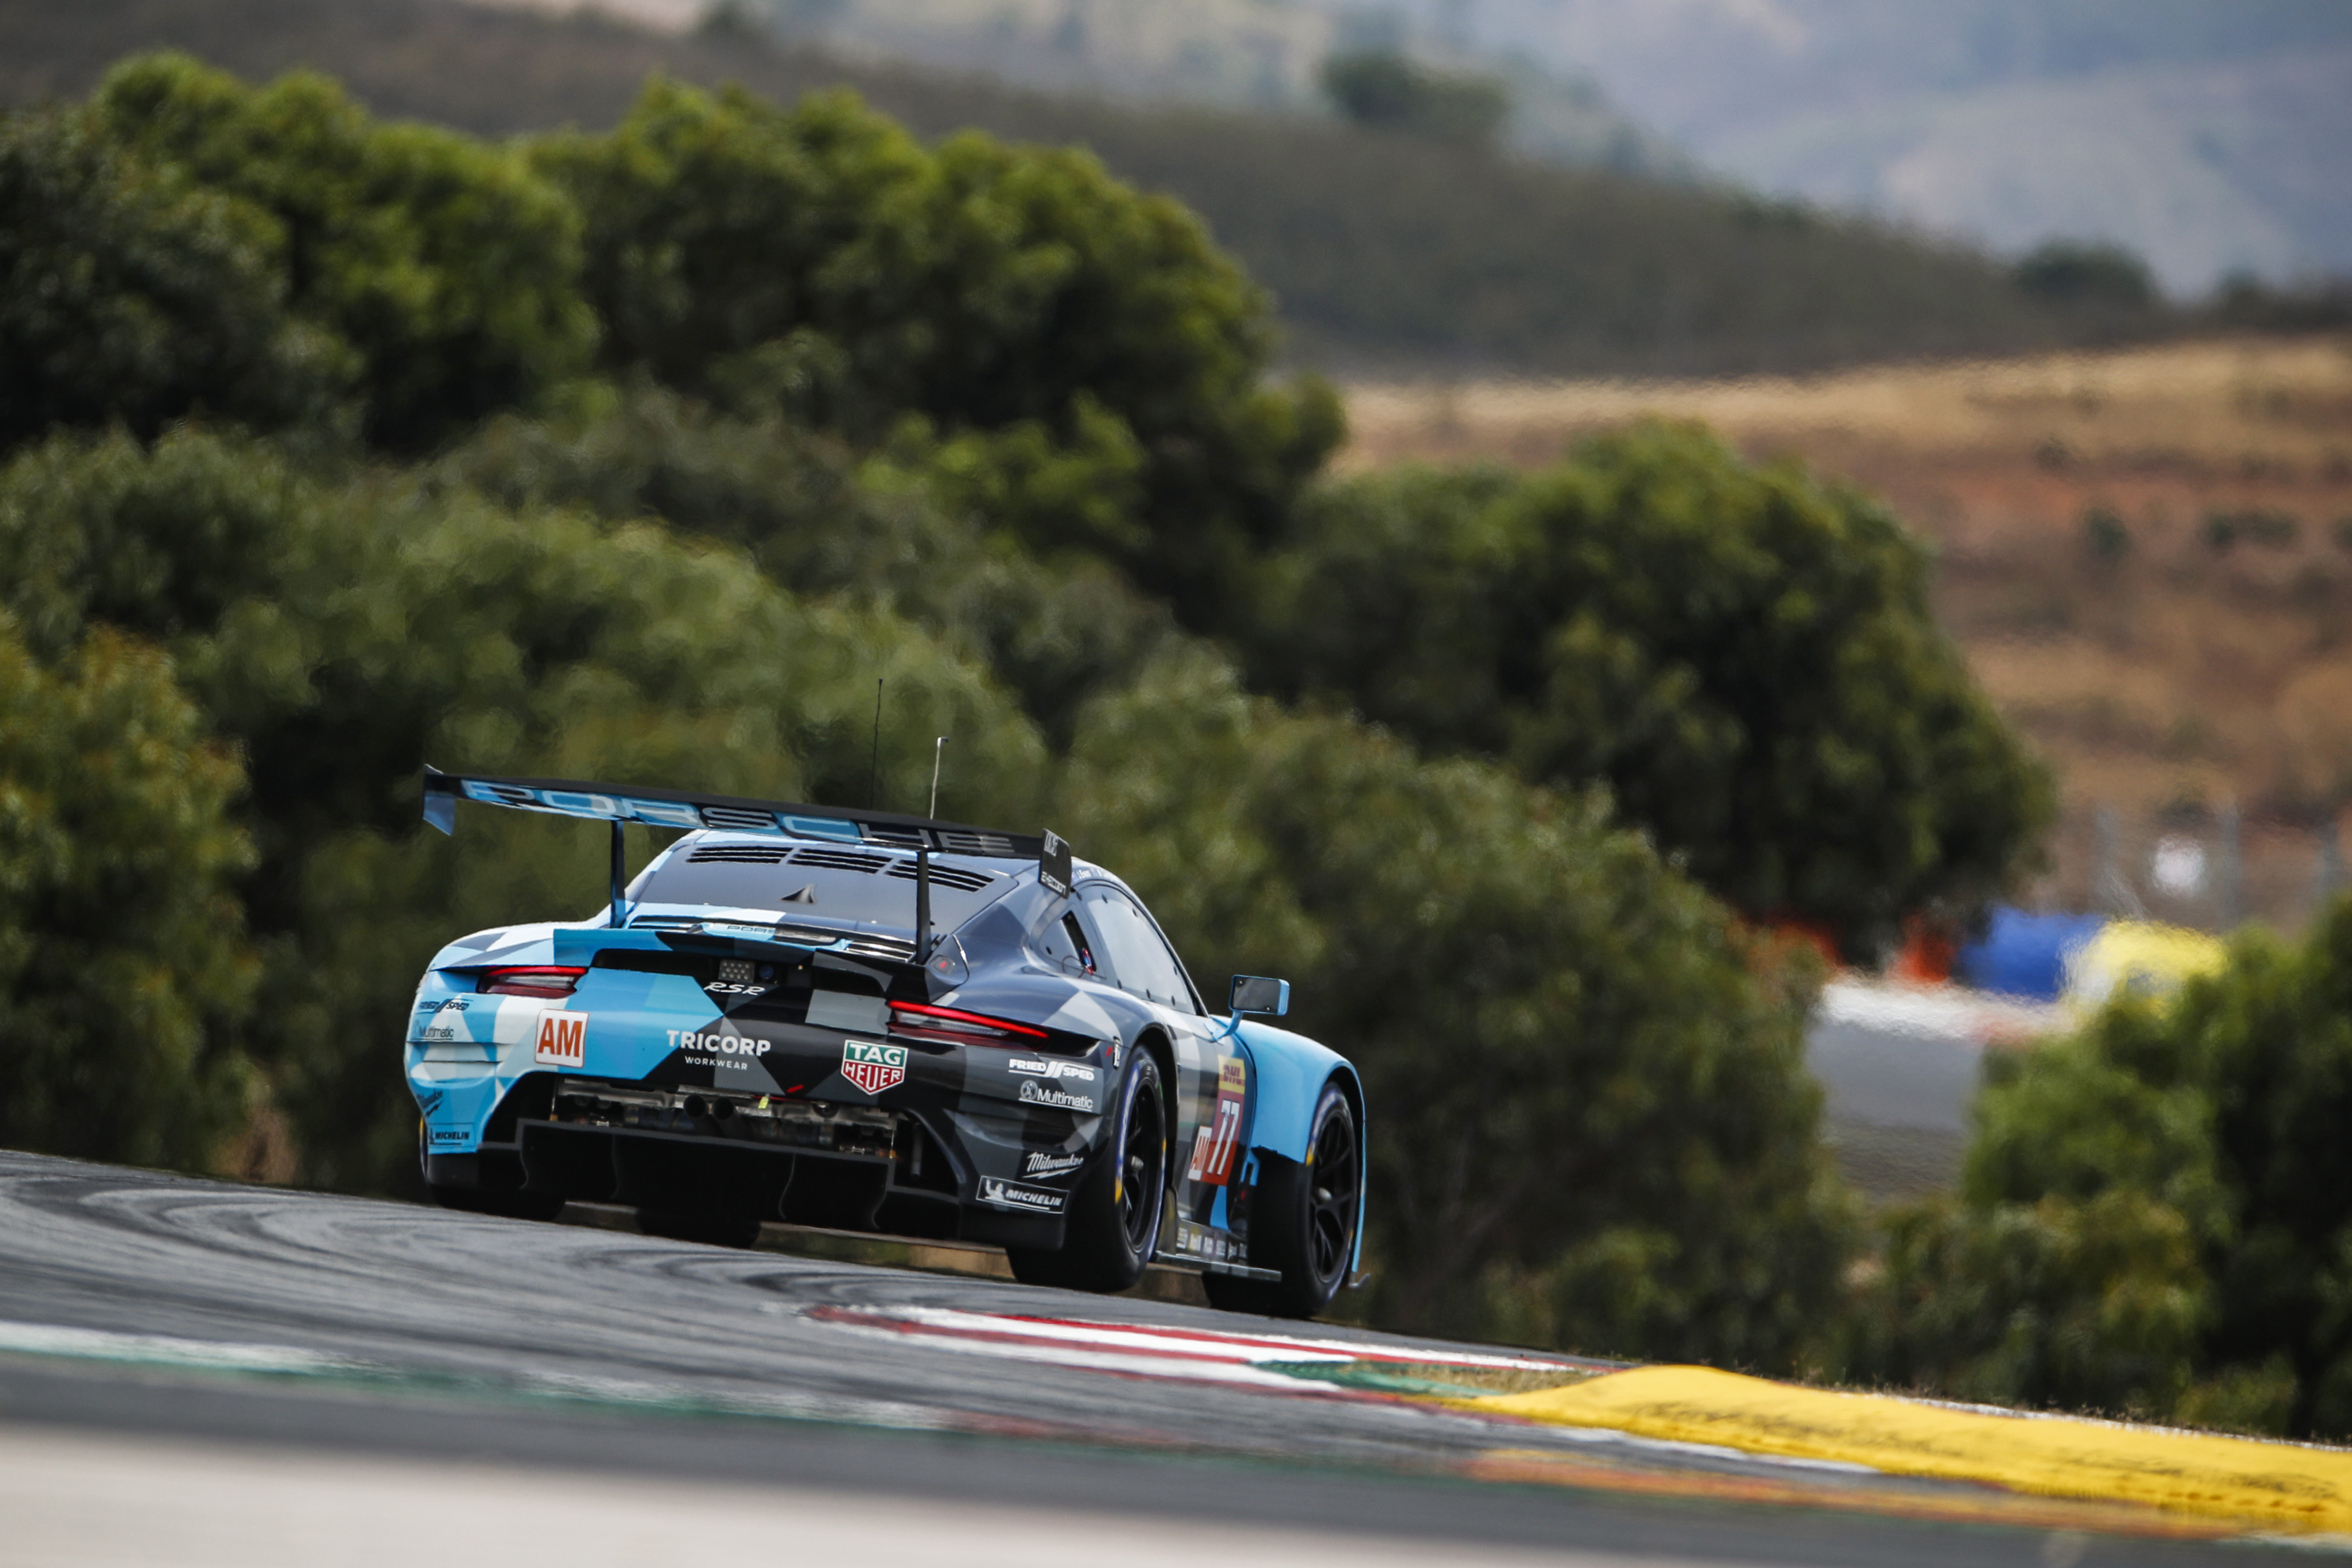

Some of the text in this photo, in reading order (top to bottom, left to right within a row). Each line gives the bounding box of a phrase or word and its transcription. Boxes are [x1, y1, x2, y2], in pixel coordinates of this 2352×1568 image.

[461, 780, 1015, 852] PORSCHE
[704, 982, 765, 996] RSR
[538, 1018, 583, 1058] AM
[666, 1029, 771, 1056] TRICORP
[685, 1055, 748, 1070] WORKWEAR
[849, 1043, 902, 1065] TAG
[845, 1062, 901, 1091] HEUER
[1009, 1058, 1095, 1081] FRIED SPED
[1037, 1088, 1093, 1109] Multimatic
[435, 1131, 470, 1140] MICHELIN
[1207, 1099, 1240, 1175] 77
[1005, 1189, 1062, 1207] MICHELIN
